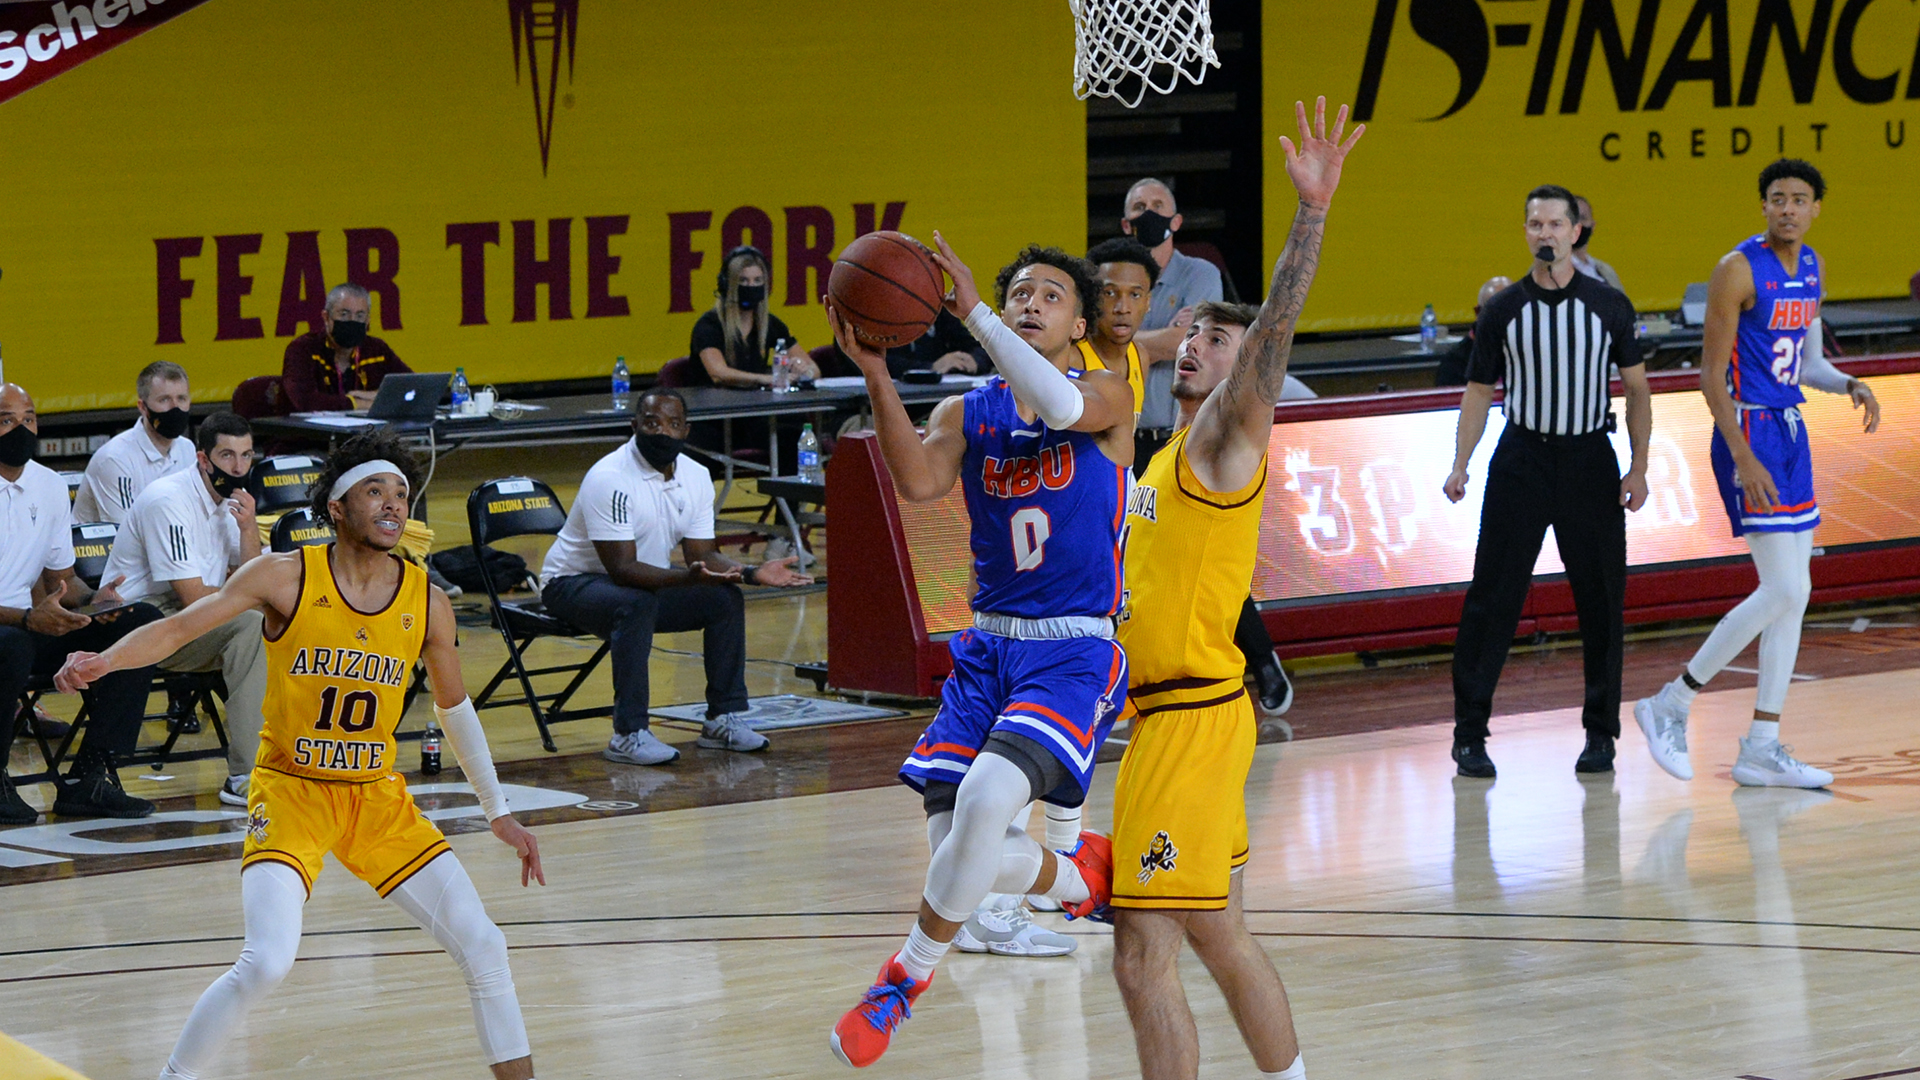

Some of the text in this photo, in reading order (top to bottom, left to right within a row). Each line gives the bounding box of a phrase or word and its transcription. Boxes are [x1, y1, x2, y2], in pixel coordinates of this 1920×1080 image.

[0, 0, 165, 81] Sche
[1600, 122, 1828, 161] CREDIT
[152, 202, 907, 345] FEAR THE FOR
[1767, 298, 1817, 331] HBU
[263, 474, 301, 488] ARIZONA
[981, 441, 1077, 499] HBU
[487, 496, 552, 515] ARIZONA STATE
[73, 544, 107, 559] RIZONA
[290, 527, 331, 542] ARIZONA
[1009, 505, 1052, 573] 0
[289, 647, 407, 688] ARIZONA
[313, 685, 379, 734] 10
[293, 737, 386, 771] STATE
